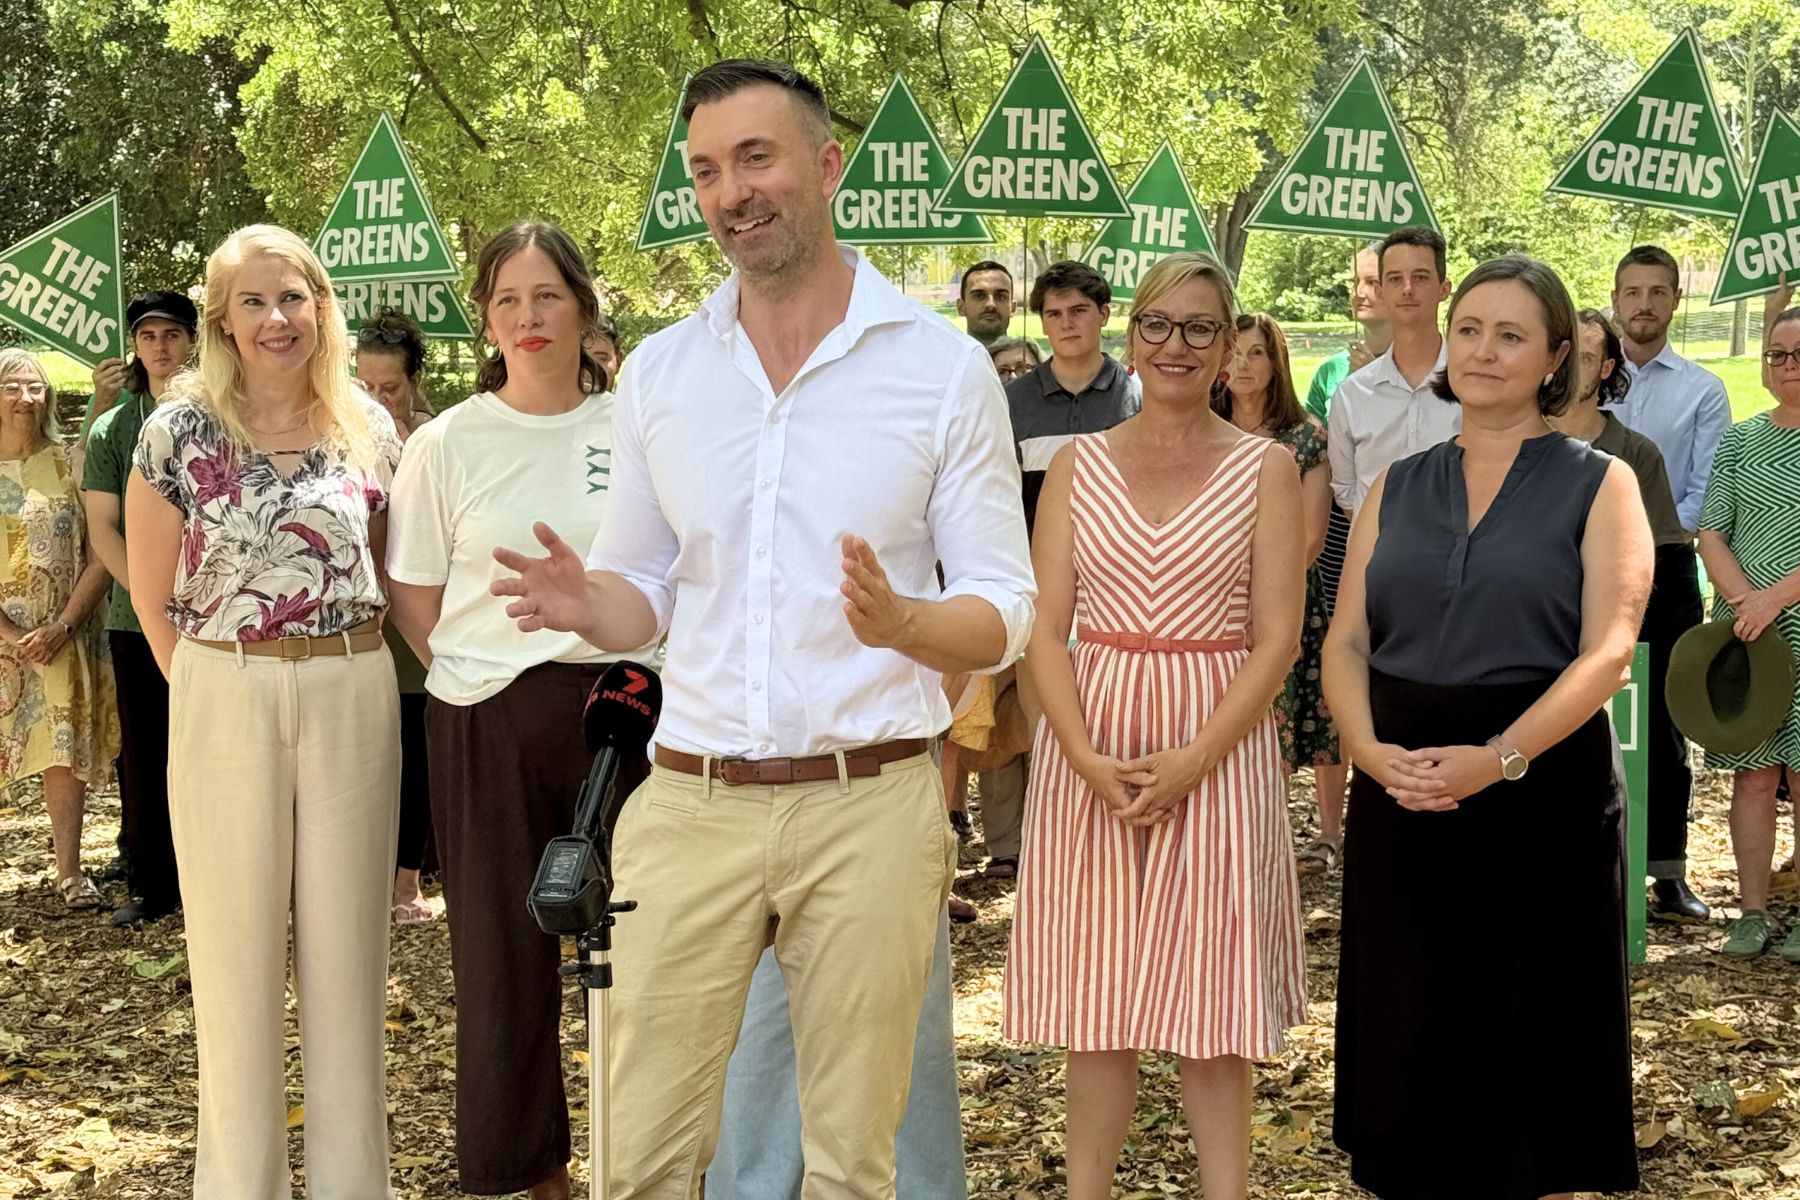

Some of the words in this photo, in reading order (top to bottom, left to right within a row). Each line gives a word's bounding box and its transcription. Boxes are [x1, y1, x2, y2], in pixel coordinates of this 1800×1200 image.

[1002, 107, 1067, 151] THE
[1636, 96, 1703, 146] THE
[868, 142, 929, 182] THE
[1324, 127, 1387, 173] THE
[1586, 140, 1726, 199] GREENS
[353, 178, 405, 220] THE
[964, 156, 1099, 201] GREENS
[1281, 173, 1413, 224] GREENS
[1758, 174, 1800, 224] TH
[320, 221, 429, 268] GREENS
[1129, 203, 1189, 248] THE
[42, 237, 111, 300] THE
[1735, 226, 1800, 279] GRE
[0, 262, 117, 353] GREENS
[602, 690, 651, 715] NEWS
